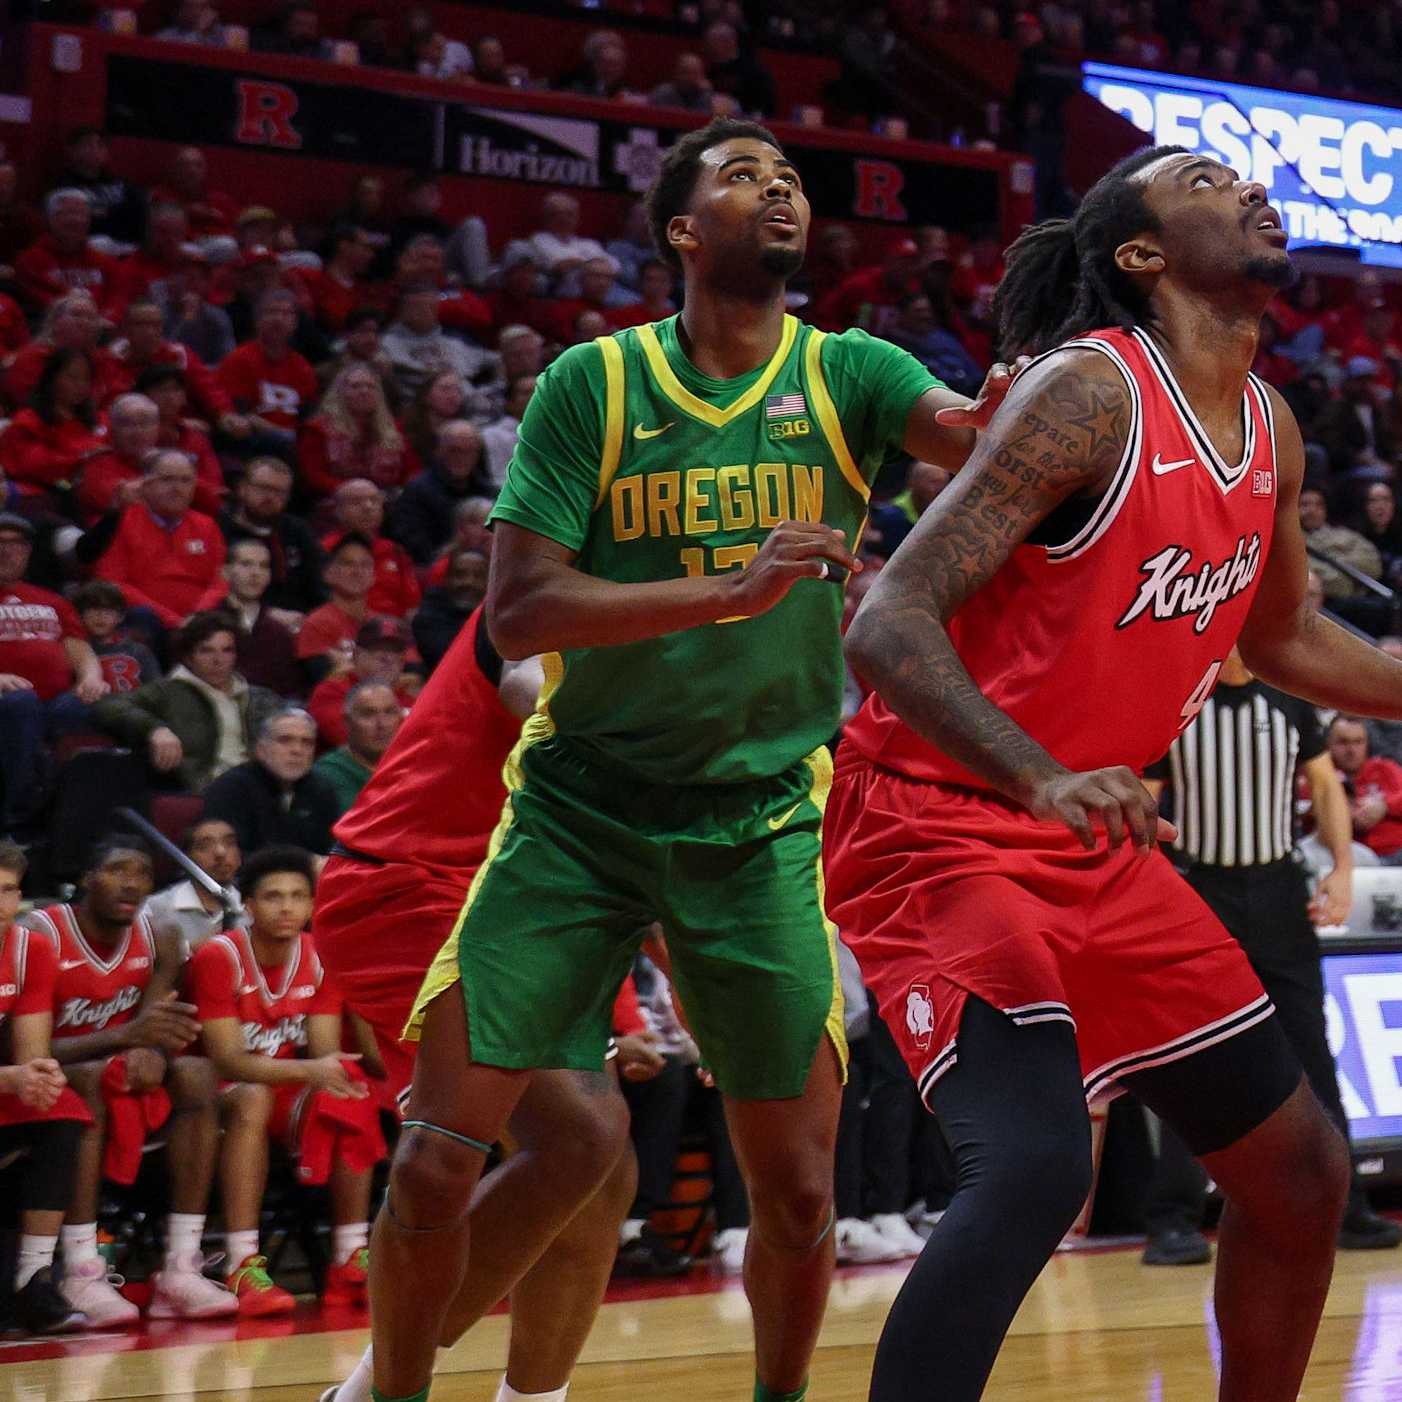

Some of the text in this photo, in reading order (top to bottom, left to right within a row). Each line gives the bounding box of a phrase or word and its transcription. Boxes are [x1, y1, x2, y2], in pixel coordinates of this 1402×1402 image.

[236, 78, 302, 151] R
[459, 133, 600, 188] Horizon
[854, 158, 907, 222] R
[610, 462, 824, 543] OREGON
[100, 653, 141, 693] R
